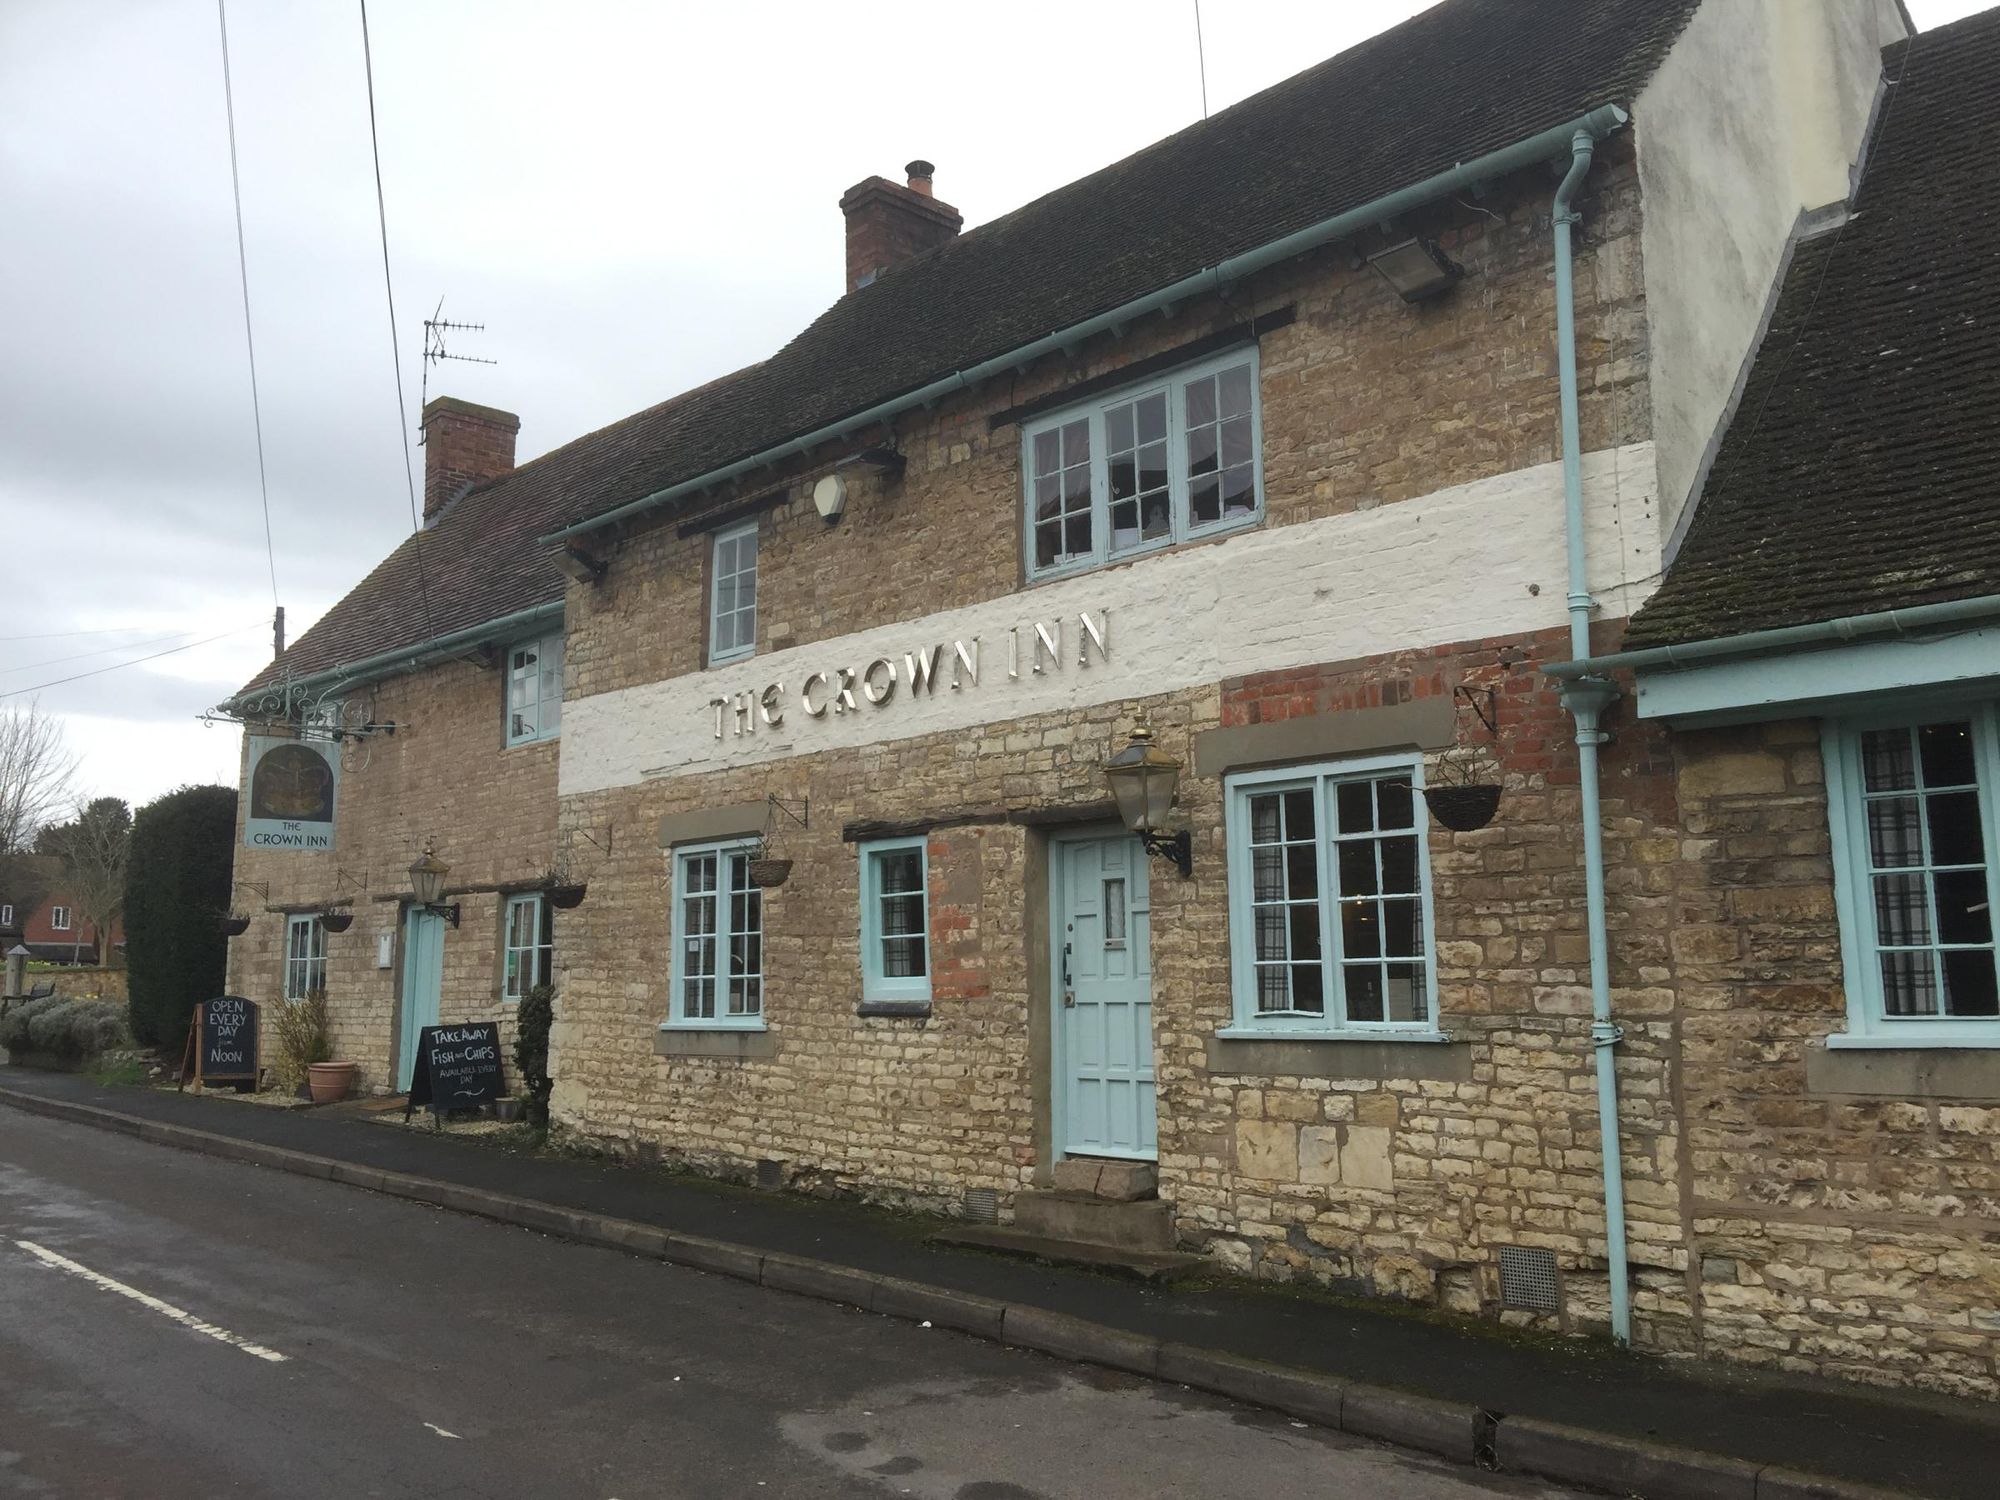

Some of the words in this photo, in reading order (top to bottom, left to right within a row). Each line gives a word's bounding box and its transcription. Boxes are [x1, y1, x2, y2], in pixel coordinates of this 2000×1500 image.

[710, 682, 784, 740] THE
[802, 635, 982, 718] CROWN
[1007, 608, 1111, 680] INN
[282, 822, 302, 831] THE
[253, 833, 303, 845] CROWN
[307, 836, 327, 846] INN
[212, 1000, 244, 1012] OPEN
[209, 1013, 247, 1026] EVERY
[217, 1026, 238, 1037] DAY
[211, 1048, 242, 1062] NOON
[431, 1049, 455, 1065] FISH
[464, 1046, 495, 1060] CHIPS
[478, 1065, 496, 1073] EVERY
[461, 1075, 472, 1084] DAY
